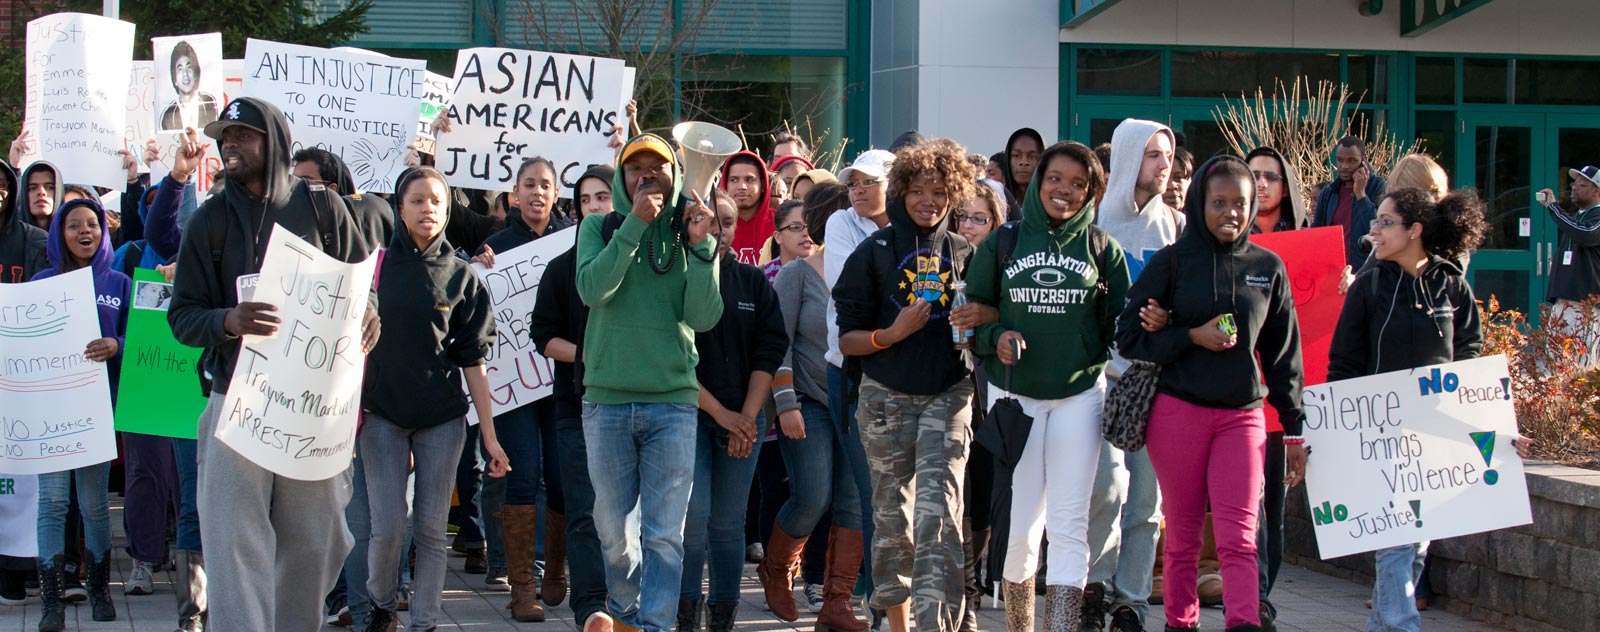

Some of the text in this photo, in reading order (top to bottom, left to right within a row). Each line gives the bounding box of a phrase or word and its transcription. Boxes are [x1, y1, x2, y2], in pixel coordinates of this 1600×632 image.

[253, 52, 289, 82] AN
[296, 55, 425, 99] INJUSTICE
[454, 52, 596, 103] ASIAN
[43, 87, 70, 97] Luis
[285, 92, 358, 113] TO ONE
[42, 101, 78, 114] Vincent
[447, 102, 618, 137] AMERICANS
[42, 118, 88, 134] Trayvon
[45, 138, 88, 152] Shaima
[494, 131, 529, 155] for
[444, 147, 600, 189] JUSC
[1005, 252, 1095, 280] BINGHAMTON
[481, 255, 549, 307] DIES
[1, 291, 75, 325] rrest
[1008, 288, 1089, 305] UNIVERSITY
[1028, 305, 1066, 314] FOOTBALL
[284, 319, 354, 373] FOR
[163, 356, 188, 373] the
[245, 346, 297, 416] Trayvon
[1302, 386, 1402, 431] Silence
[39, 415, 94, 437] Justice
[229, 396, 304, 453] ARREST
[40, 441, 85, 456] Peace
[1360, 427, 1422, 468] brings
